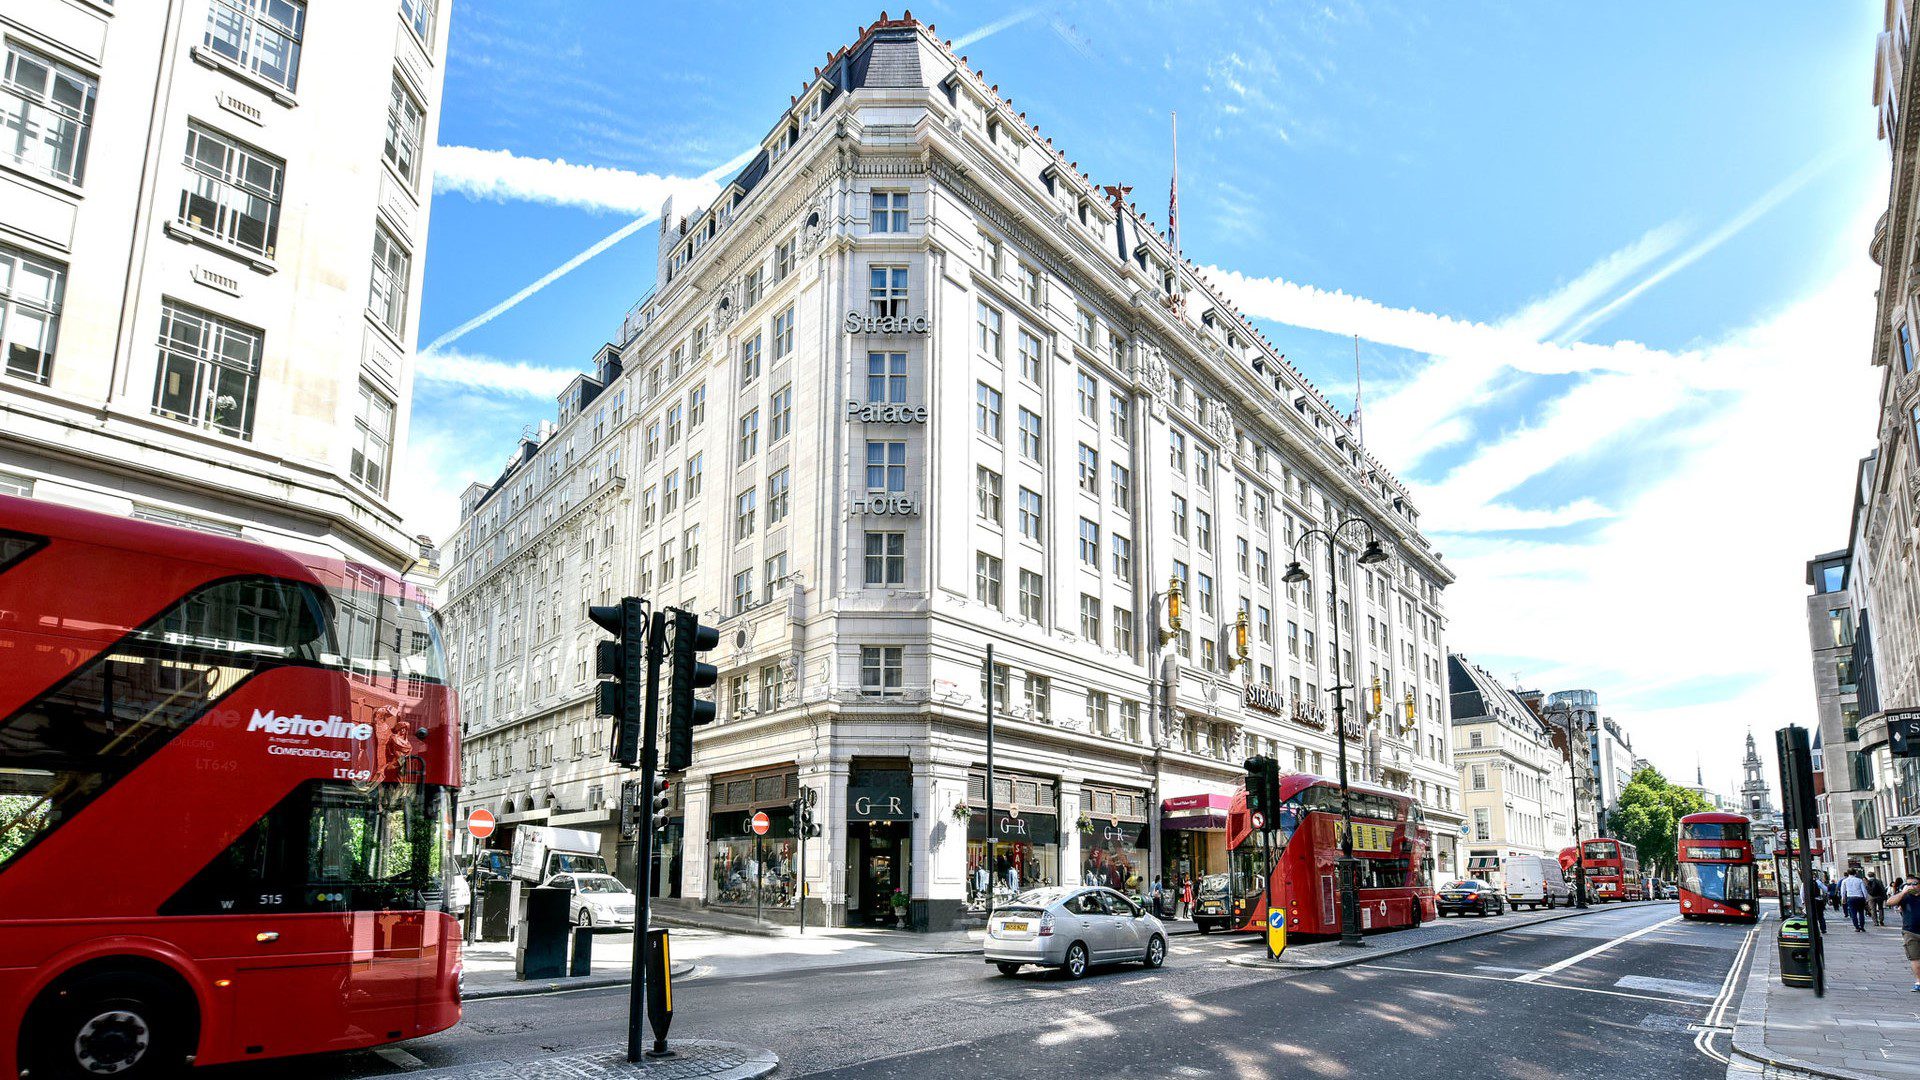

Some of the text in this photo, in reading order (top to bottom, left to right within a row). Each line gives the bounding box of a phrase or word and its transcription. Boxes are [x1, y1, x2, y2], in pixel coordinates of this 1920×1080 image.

[844, 310, 928, 334] Strand
[845, 399, 928, 423] Palace
[850, 491, 921, 516] Hotel
[1248, 684, 1284, 710] STRAND
[246, 708, 373, 740] Metroline
[333, 768, 371, 780] LT649
[259, 894, 282, 904] 515
